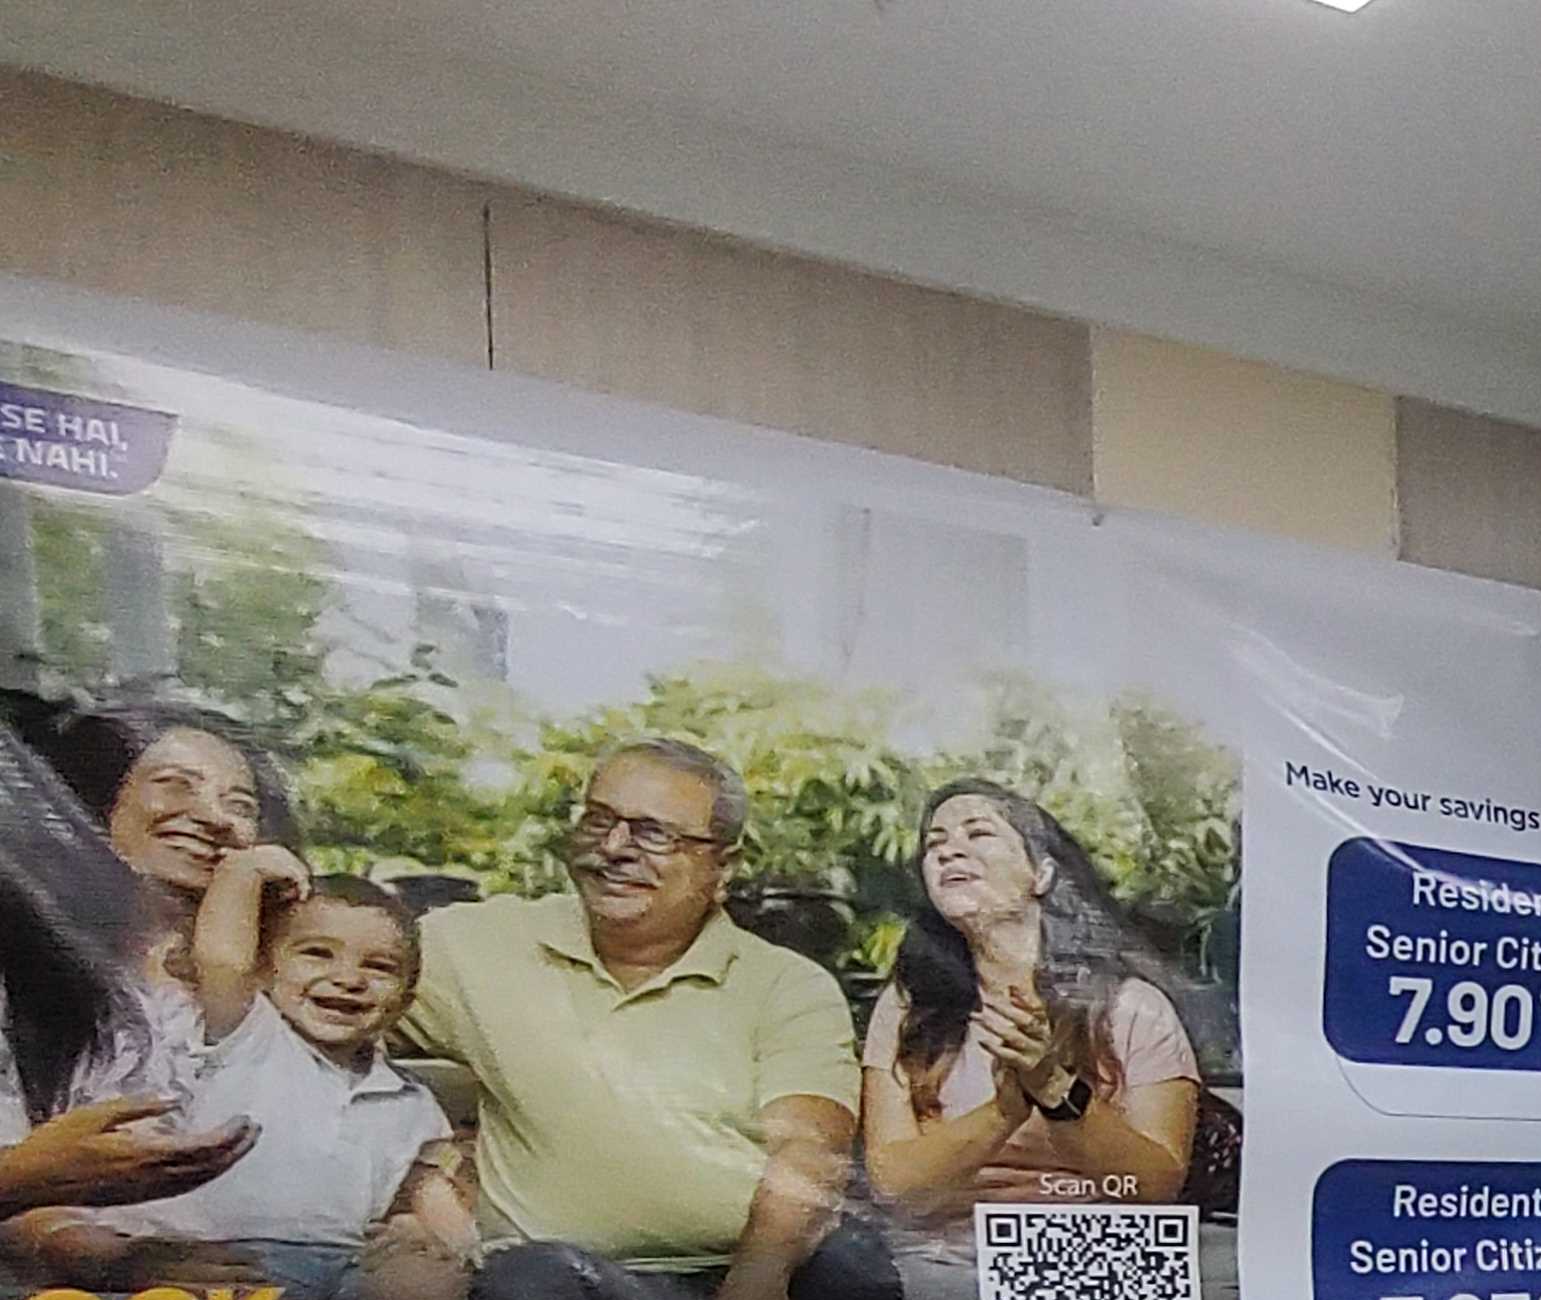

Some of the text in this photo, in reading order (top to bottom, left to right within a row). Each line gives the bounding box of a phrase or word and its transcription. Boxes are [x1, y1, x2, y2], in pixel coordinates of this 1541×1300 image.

[0, 404, 128, 451] SE HAI,
[16, 438, 118, 478] NAHI.
[1286, 761, 1360, 798] Make
[1368, 785, 1431, 812] your
[1439, 796, 1540, 831] savings
[1366, 925, 1487, 967] Senior
[1040, 1174, 1138, 1198] Scan QR
[1350, 1239, 1467, 1274] Senior
